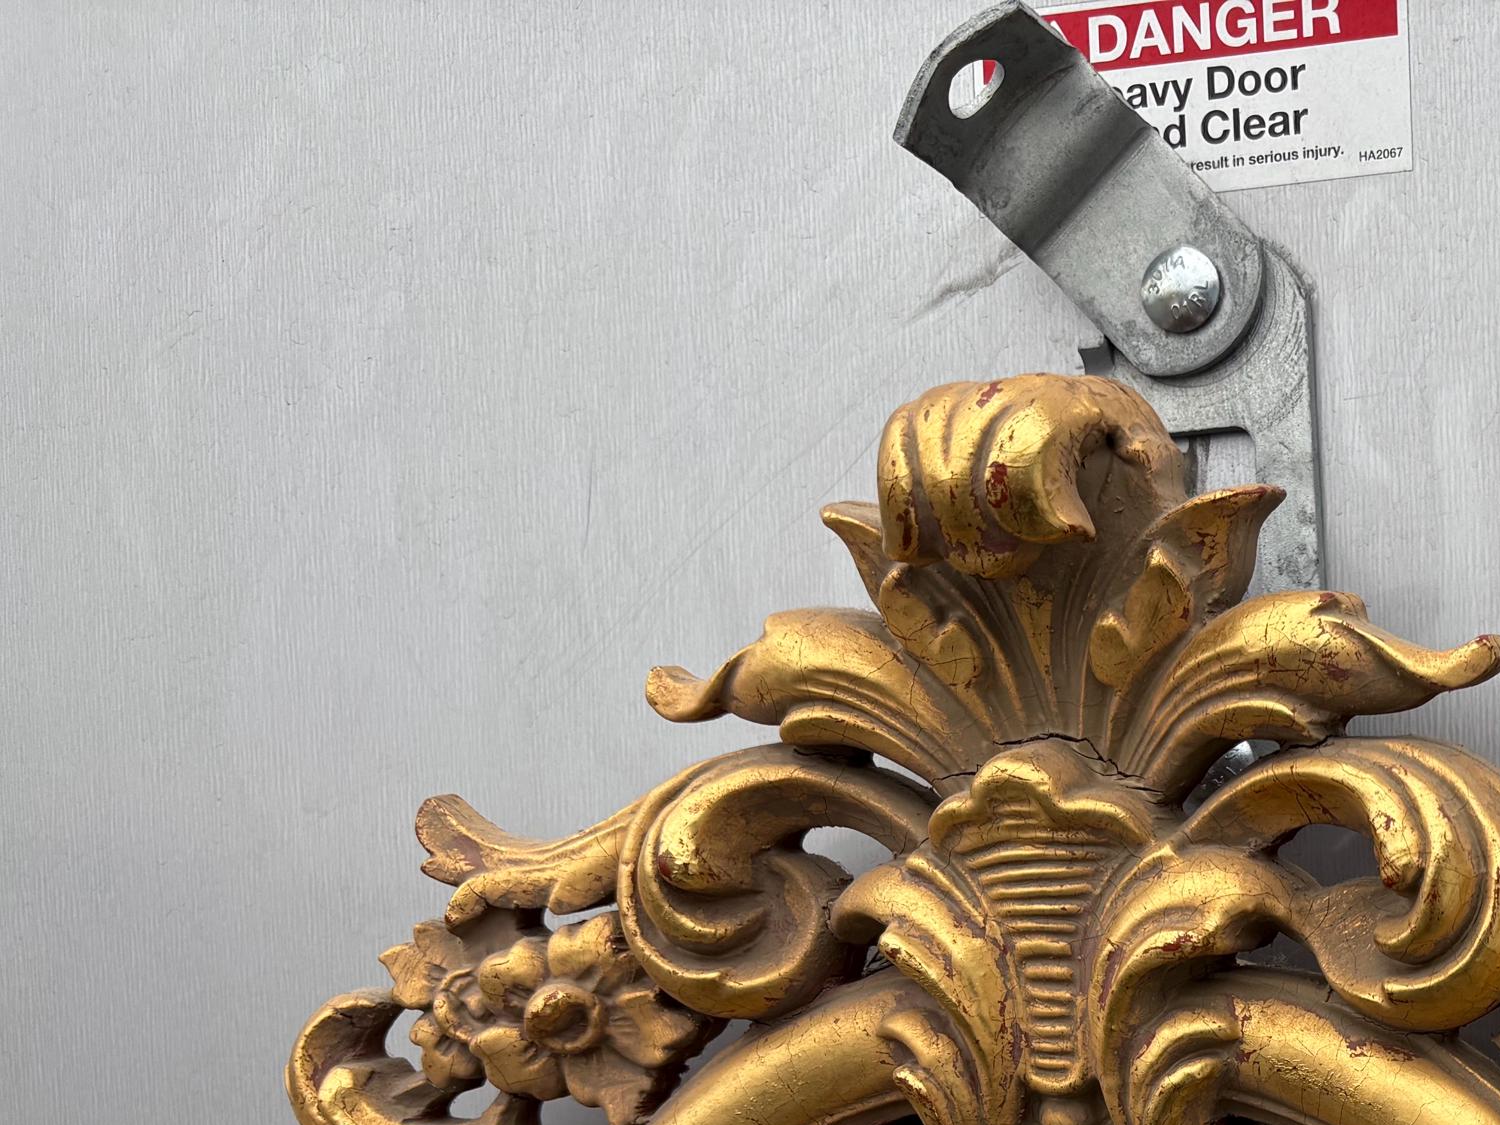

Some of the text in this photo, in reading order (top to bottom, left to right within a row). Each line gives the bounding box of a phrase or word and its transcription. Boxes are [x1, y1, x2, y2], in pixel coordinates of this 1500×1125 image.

[1088, 0, 1340, 63] DANGER
[1112, 64, 1306, 112] avy Door
[1201, 108, 1308, 145] Clear
[1190, 145, 1344, 171] result in serious injury.
[1359, 147, 1403, 162] HA2067
